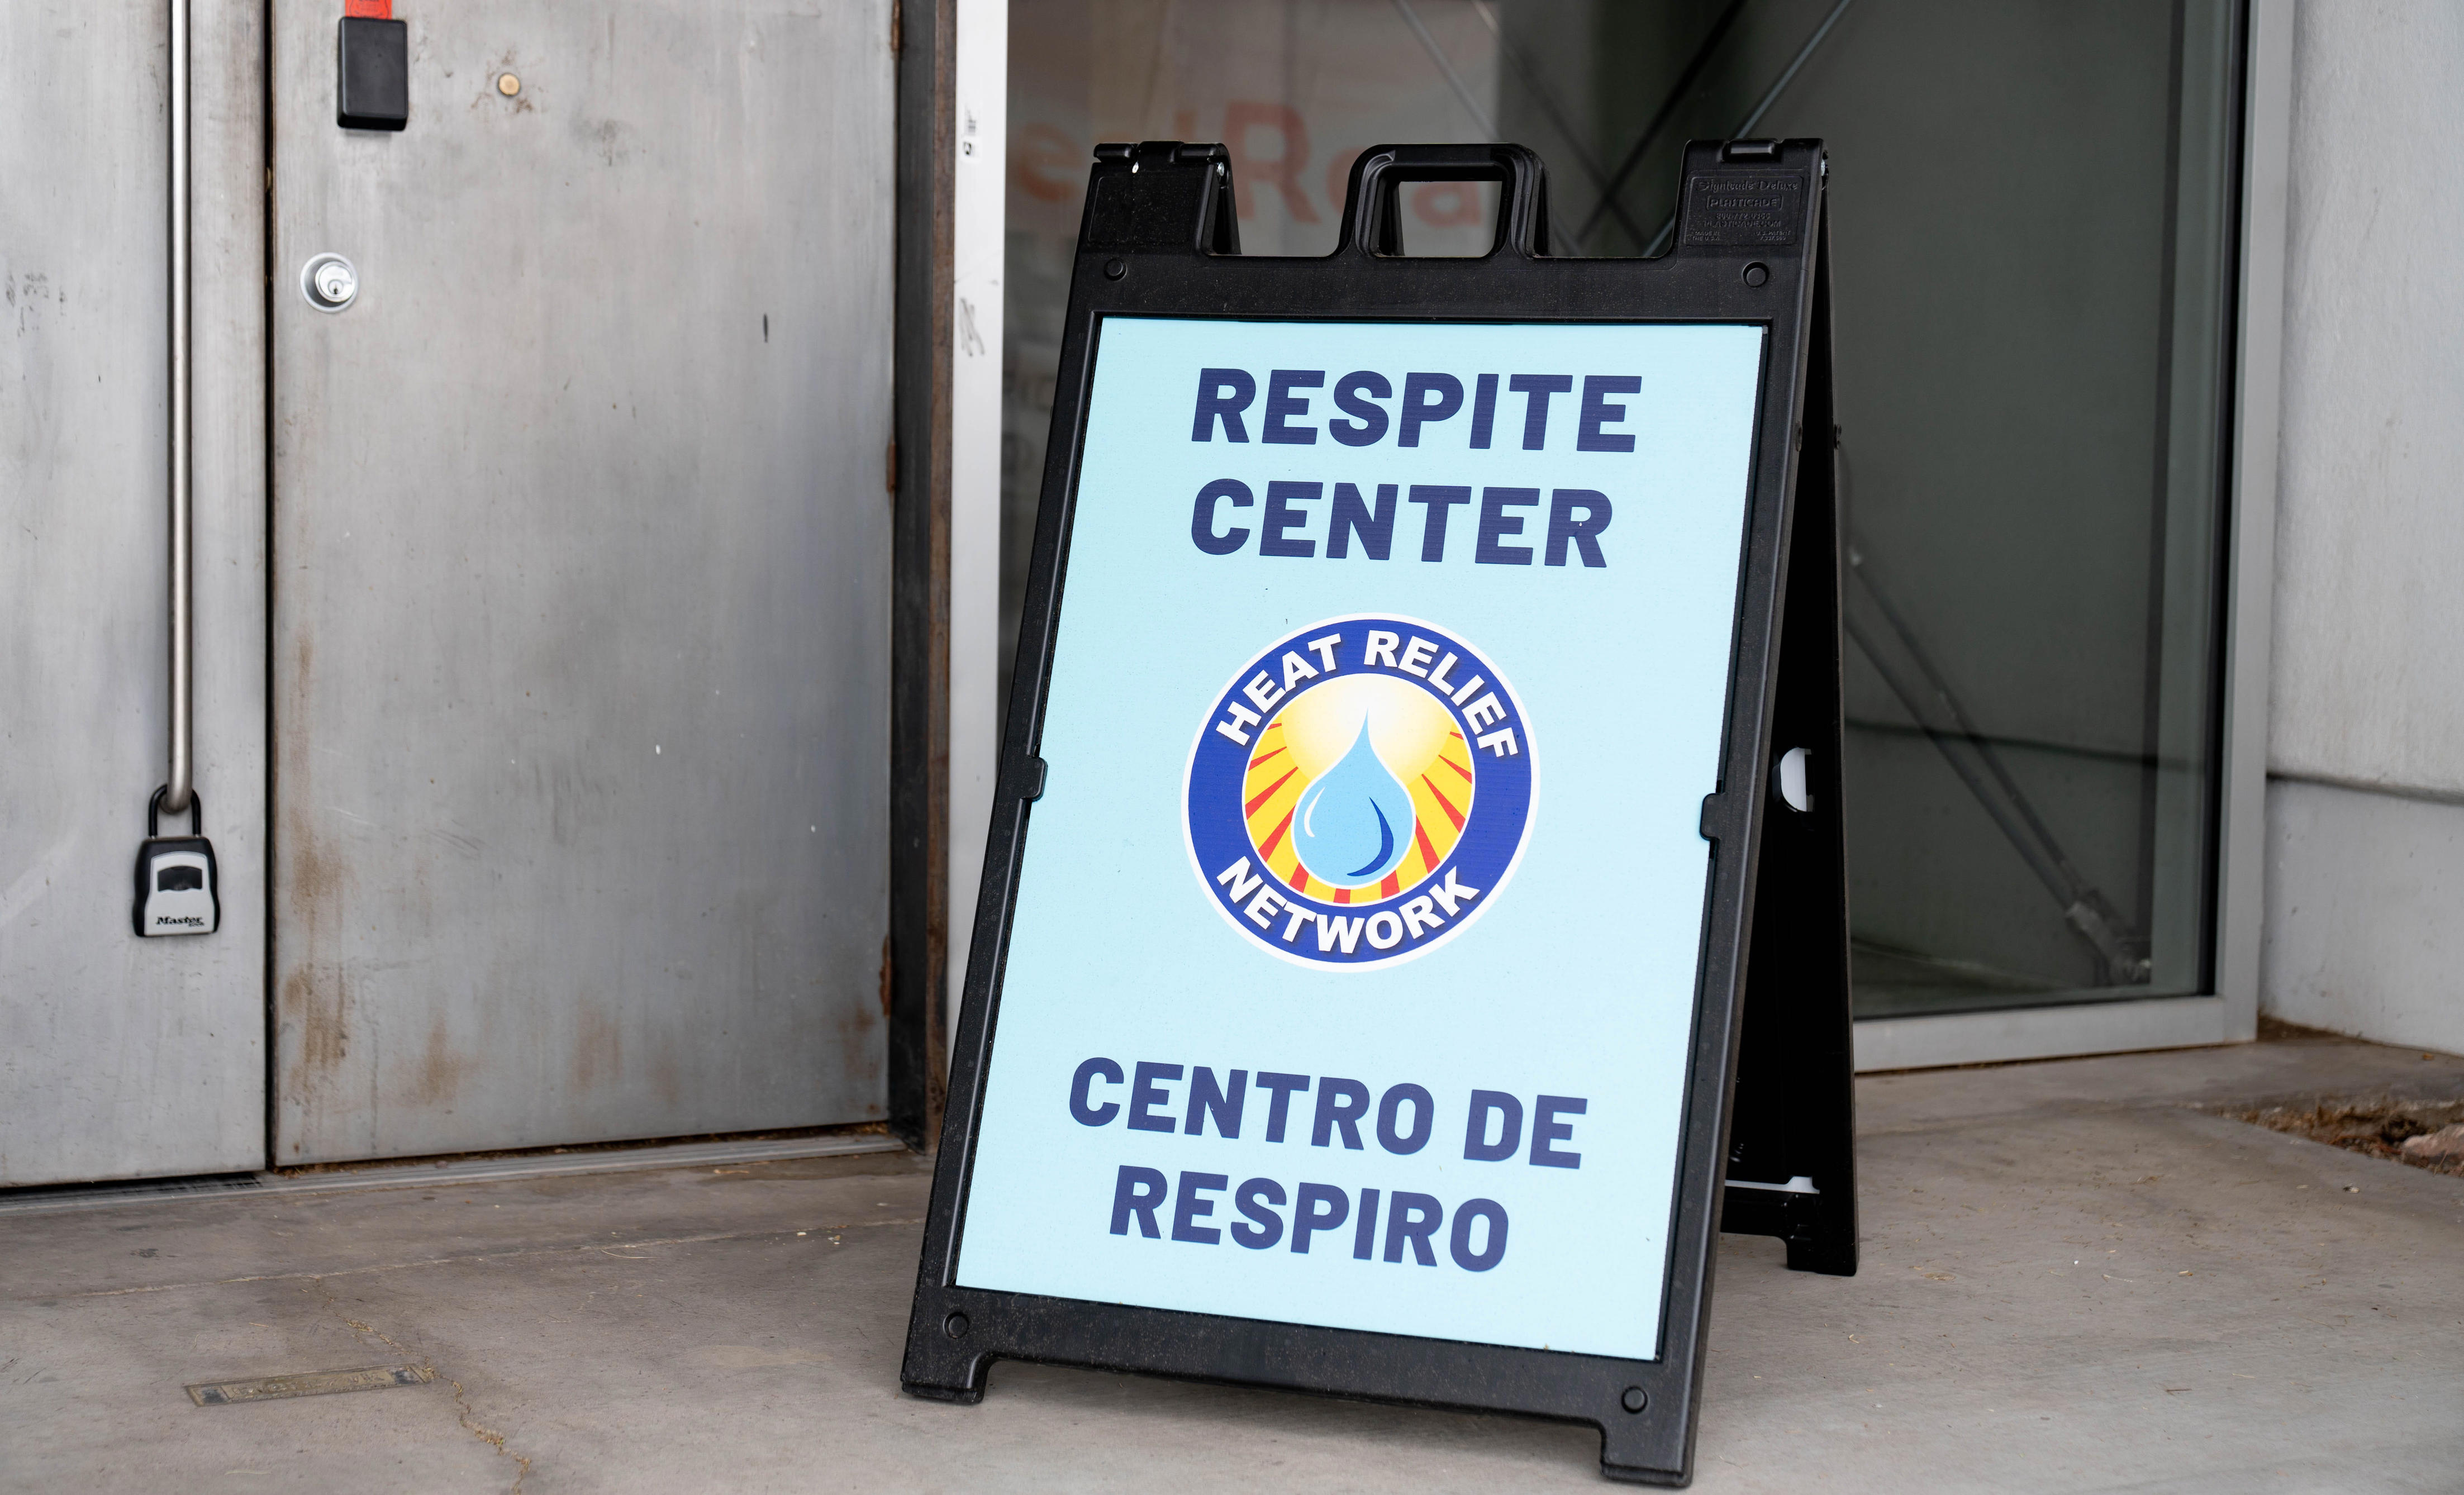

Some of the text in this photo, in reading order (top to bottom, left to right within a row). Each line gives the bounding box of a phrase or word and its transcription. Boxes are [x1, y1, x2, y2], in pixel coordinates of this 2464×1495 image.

[1710, 198, 1777, 207] PLASTICADE
[1756, 180, 1797, 192] Deluxe
[1192, 368, 1642, 452] RESPITE
[1192, 479, 1612, 568] CENTER
[1215, 630, 1519, 757] HEAT RELIEF
[156, 916, 203, 925] Master
[1216, 855, 1480, 954] NETWORK
[1069, 1058, 1587, 1169] CENTRO DE
[1110, 1165, 1508, 1272] RESPIRO
